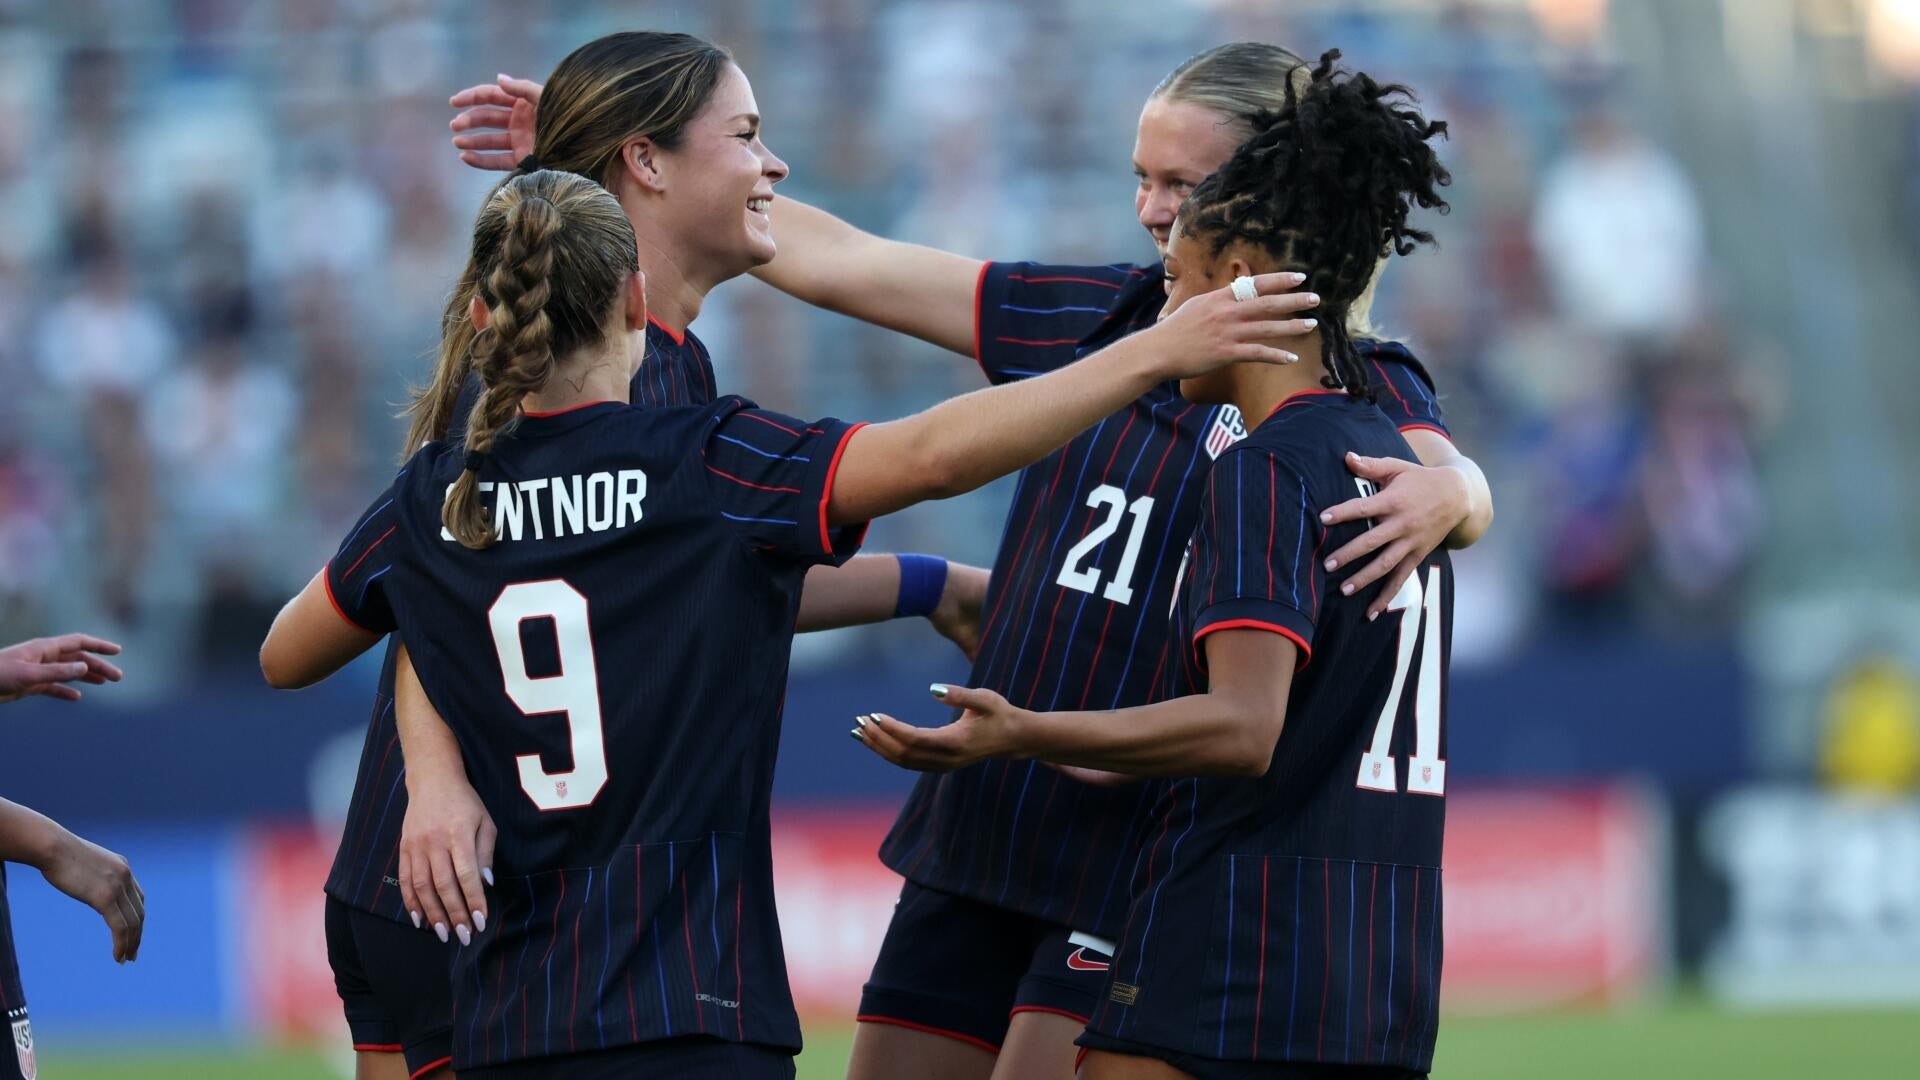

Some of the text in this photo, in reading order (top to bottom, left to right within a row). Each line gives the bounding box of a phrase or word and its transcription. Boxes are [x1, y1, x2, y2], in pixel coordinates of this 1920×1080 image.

[1220, 407, 1245, 436] US
[440, 469, 647, 541] NTNOR
[1056, 483, 1155, 606] 21
[488, 578, 609, 812] 9
